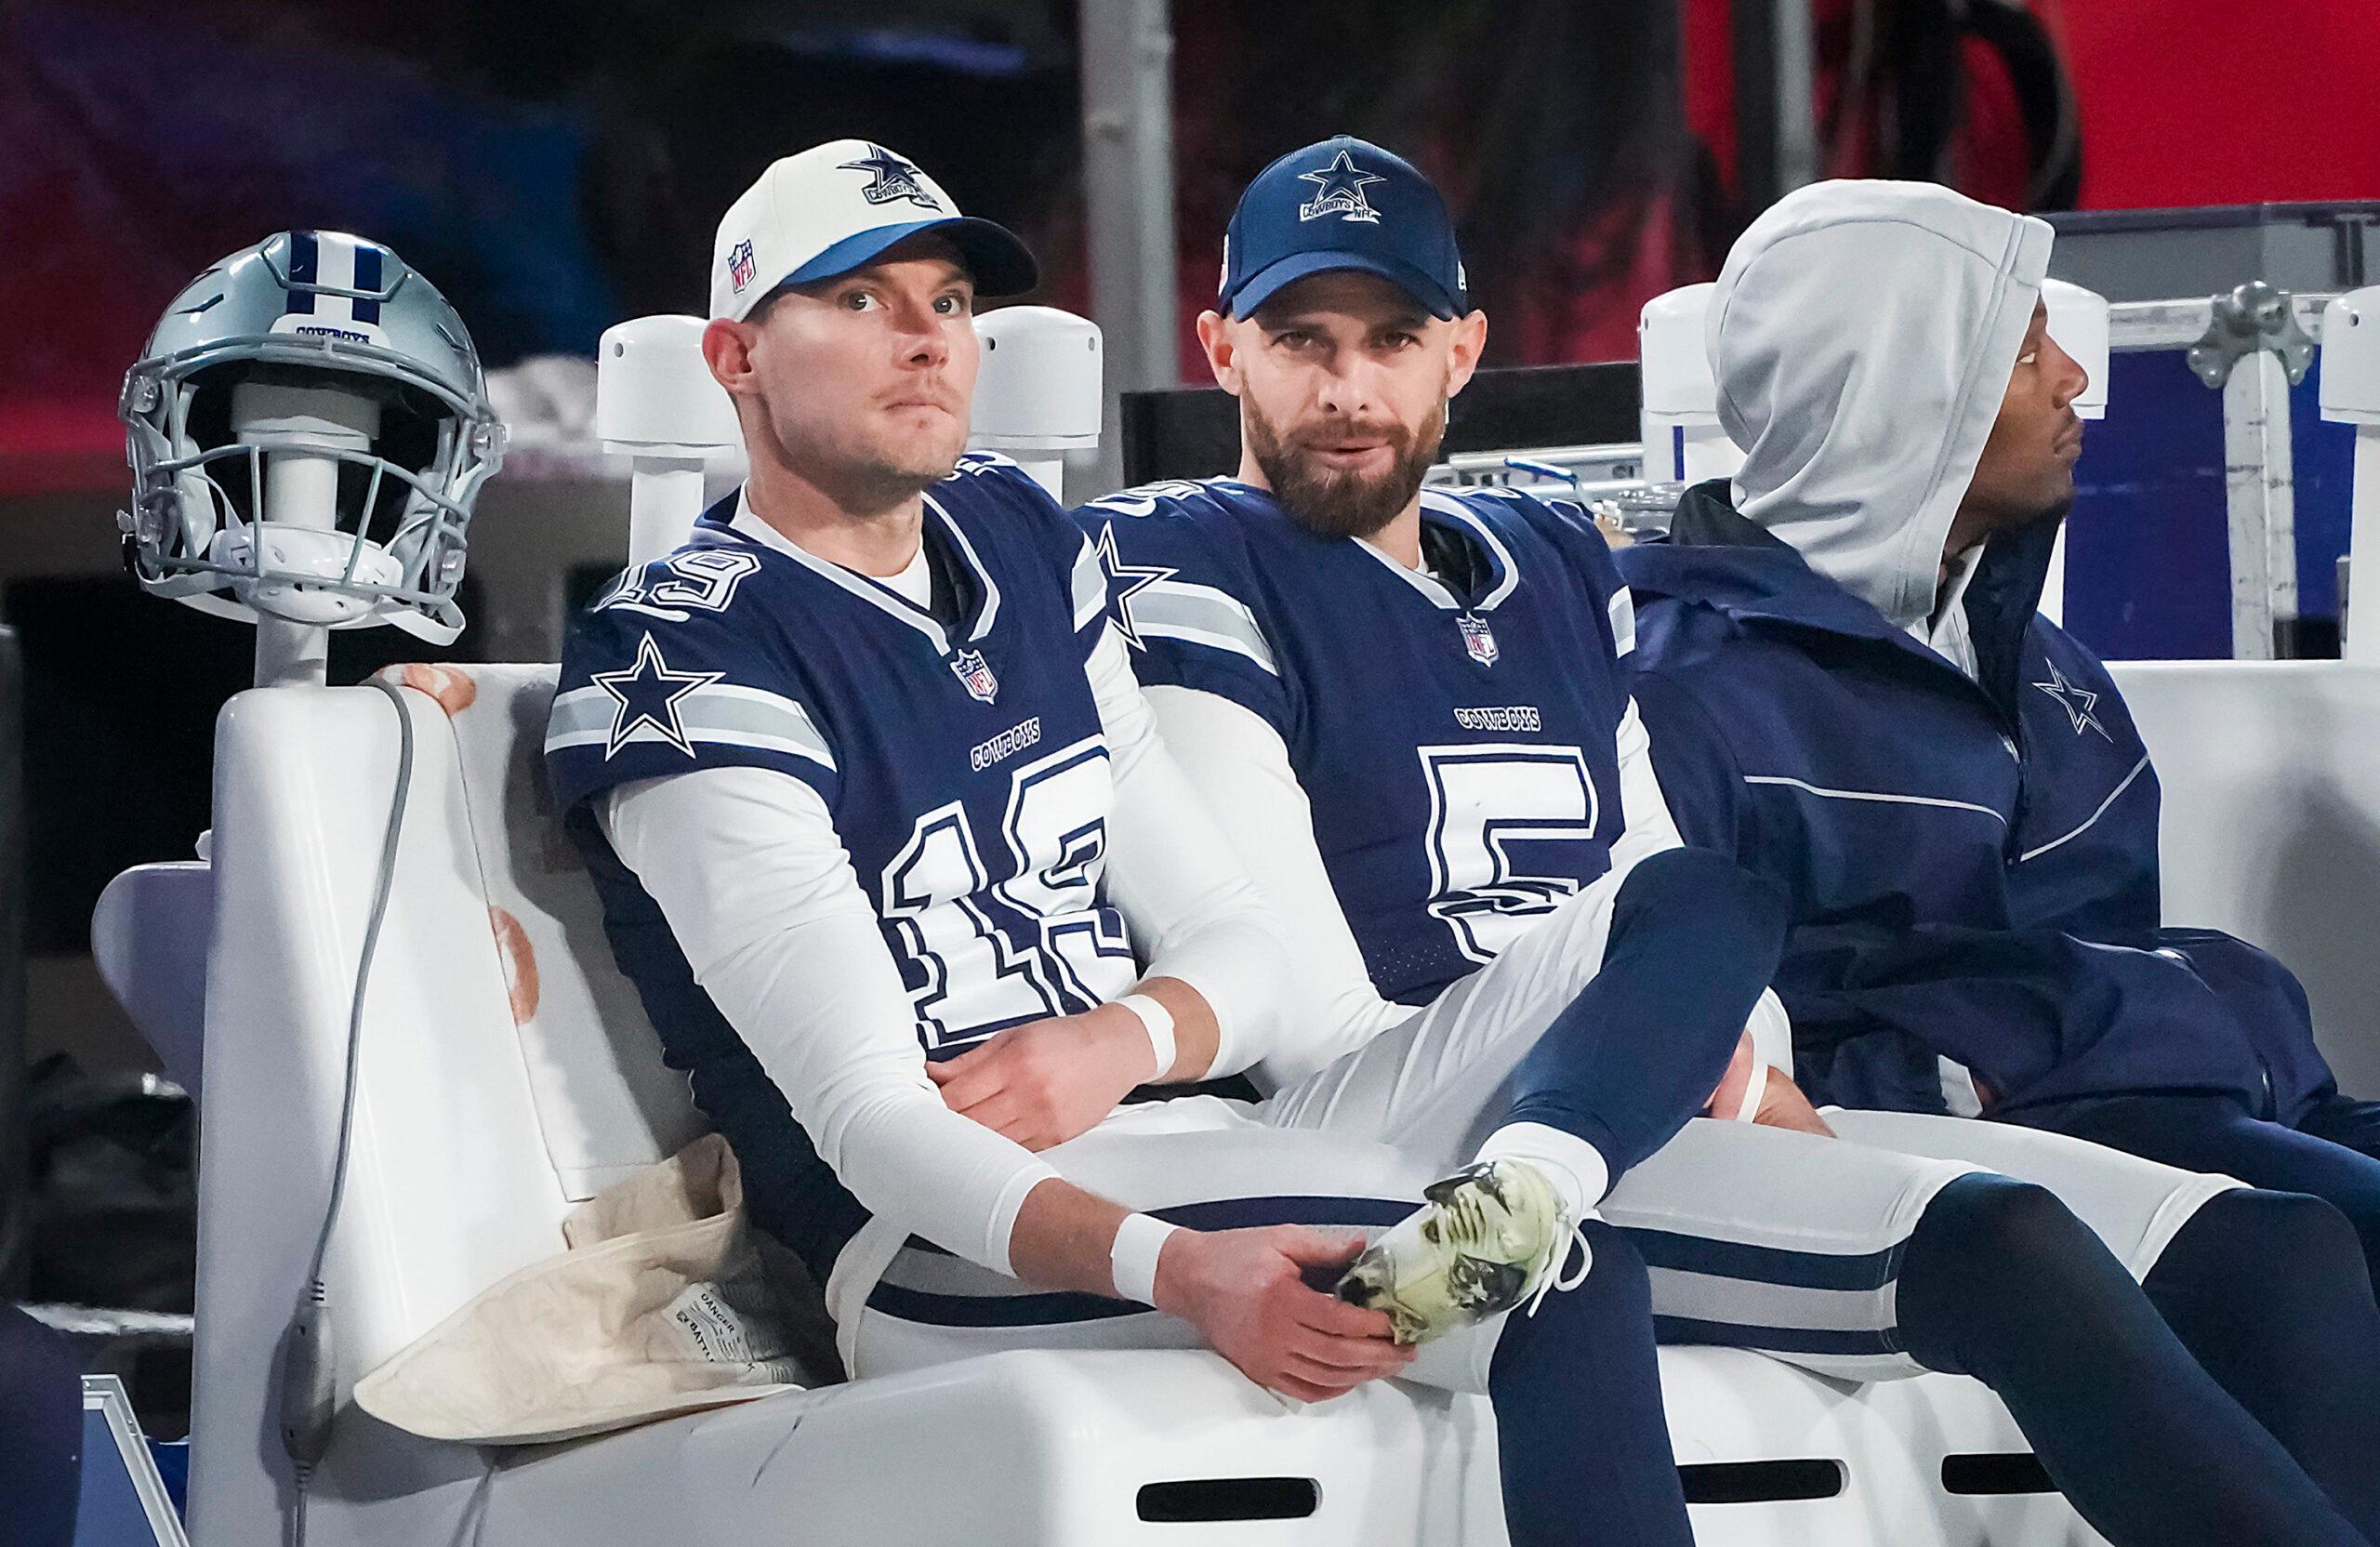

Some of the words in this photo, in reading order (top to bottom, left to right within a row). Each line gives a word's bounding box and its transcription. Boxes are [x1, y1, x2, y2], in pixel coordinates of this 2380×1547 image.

[971, 717, 1040, 772] COWBOYS
[1453, 707, 1540, 732] COWBOYS
[881, 733, 1137, 1049] 19
[1417, 743, 1599, 965] 5
